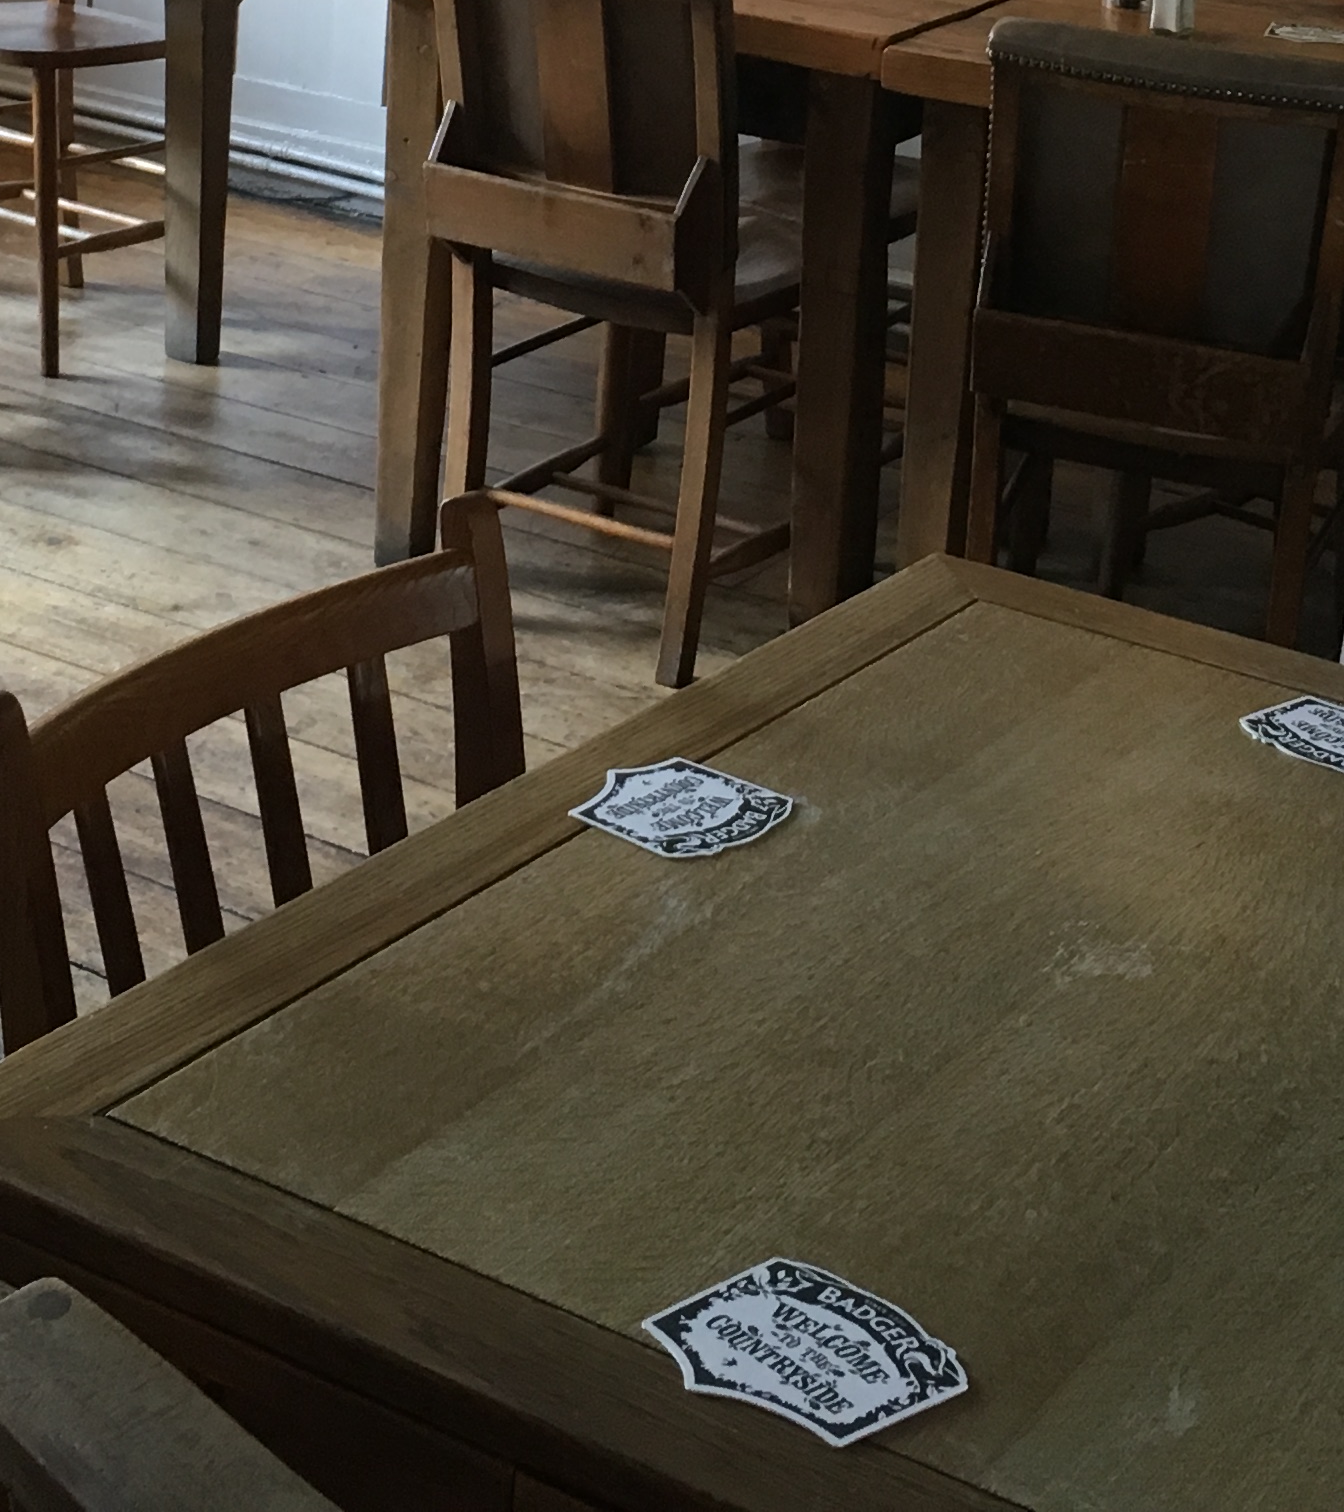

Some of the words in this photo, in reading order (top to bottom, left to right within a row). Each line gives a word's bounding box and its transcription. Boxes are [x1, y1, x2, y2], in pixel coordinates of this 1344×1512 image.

[651, 795, 734, 832] WELCOME
[706, 811, 767, 843] BADGER
[772, 1301, 891, 1385] WELCOME
[782, 1330, 802, 1349] TO
[817, 1286, 920, 1361] BADGER
[705, 1313, 855, 1416] COUNTRYSIDE
